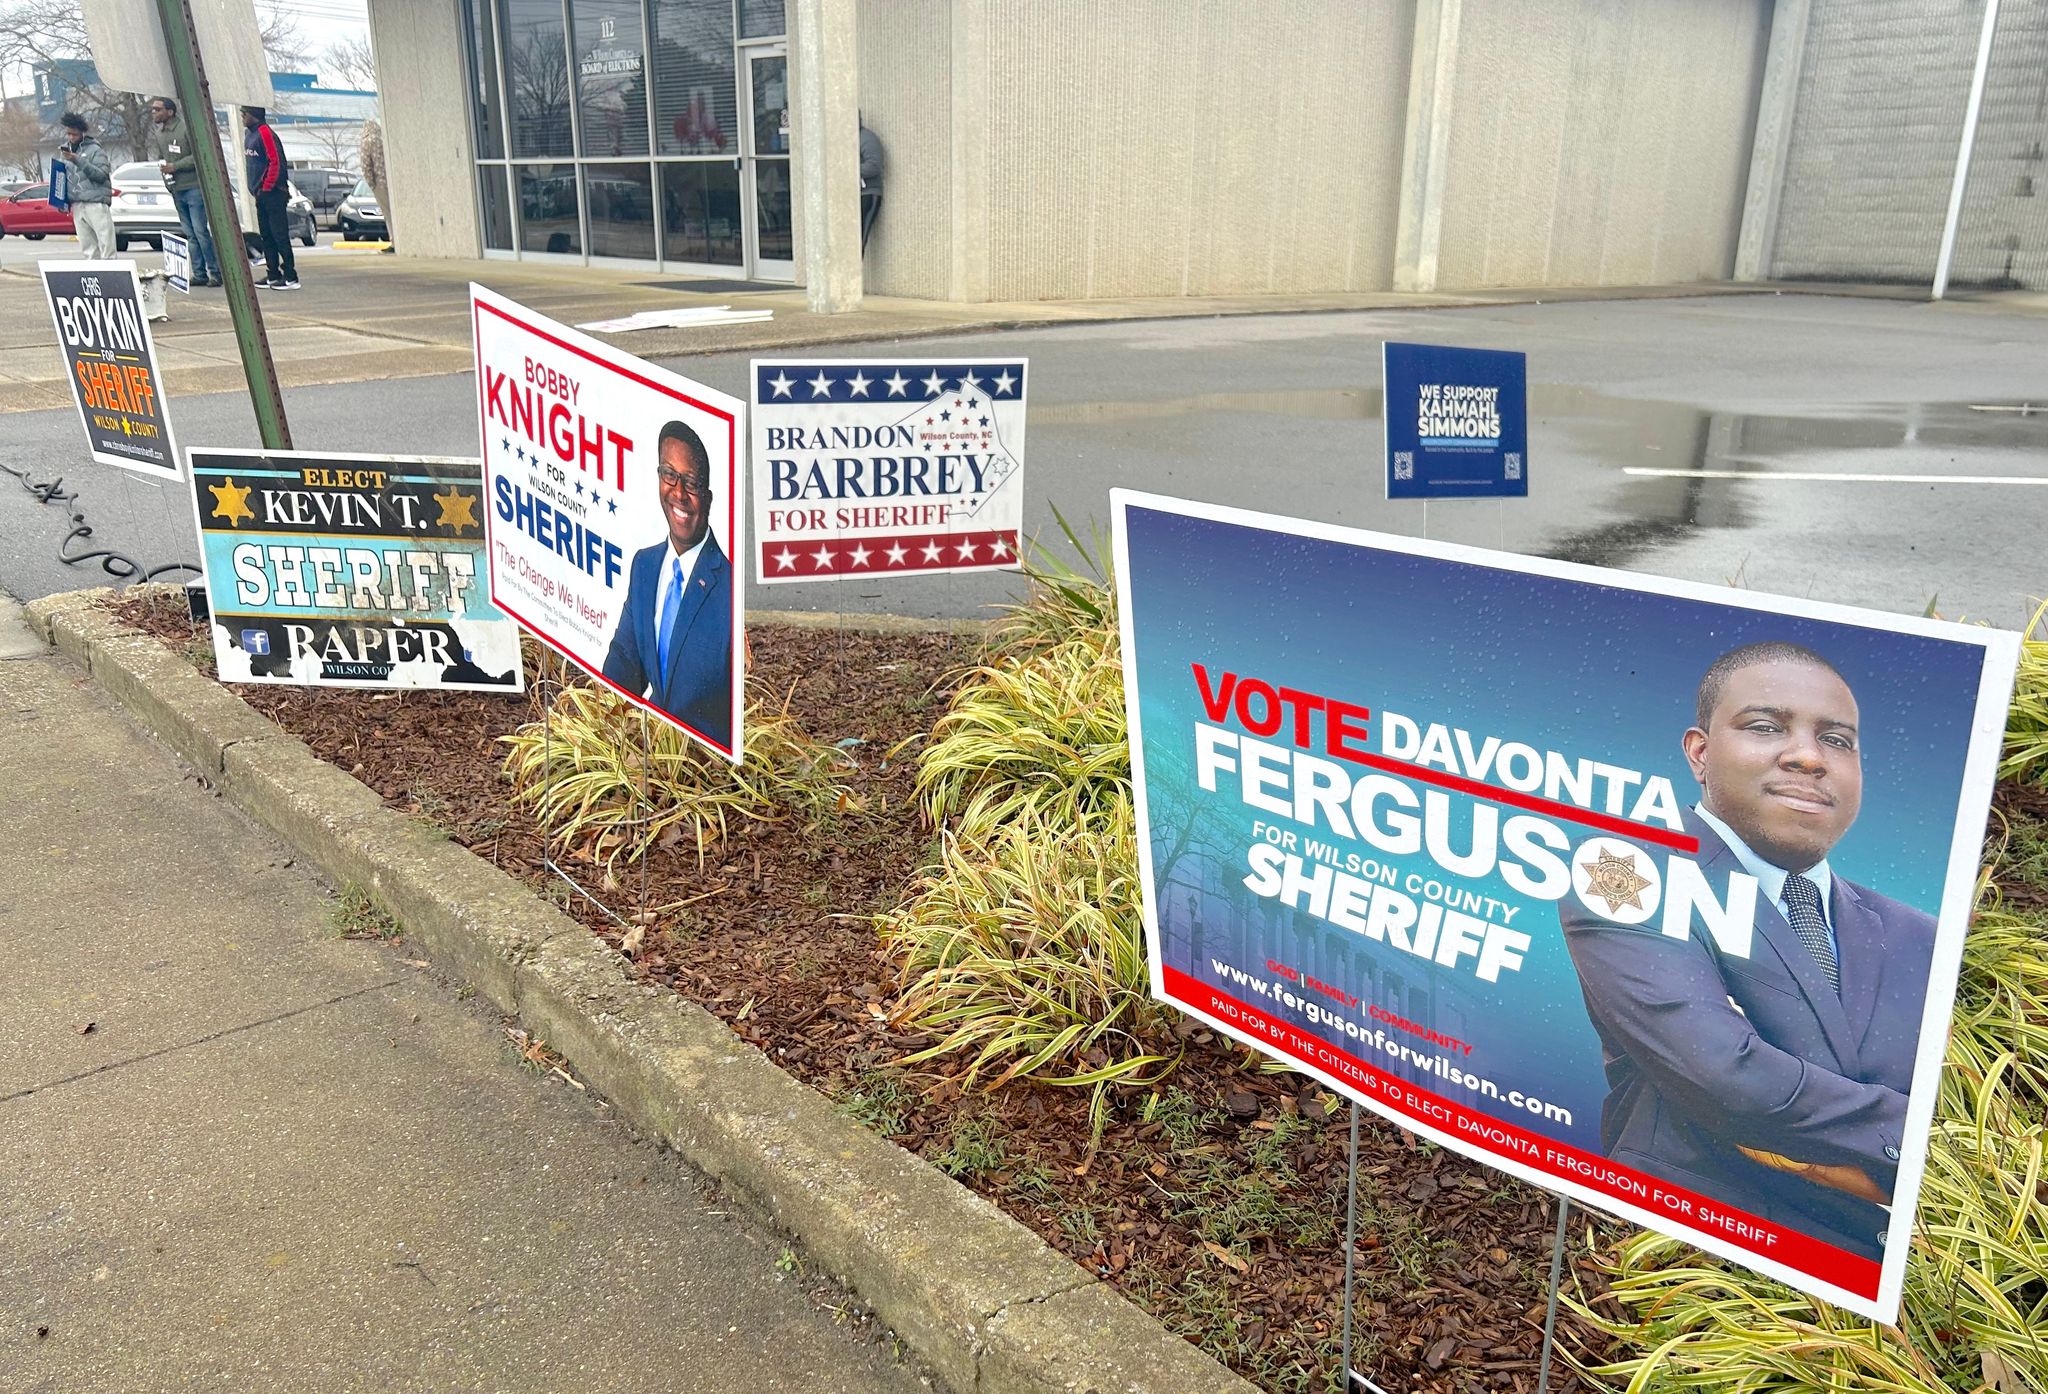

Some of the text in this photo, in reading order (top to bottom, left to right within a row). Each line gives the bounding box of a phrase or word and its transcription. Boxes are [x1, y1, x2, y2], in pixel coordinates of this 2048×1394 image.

[601, 20, 615, 38] 112
[81, 277, 102, 297] CHRIS
[56, 296, 144, 352] BOYKIN
[101, 349, 116, 362] FOR
[77, 360, 155, 417] SHERIFF
[525, 356, 580, 406] BOBBY
[1419, 384, 1499, 402] WE SUPPORT
[93, 415, 160, 439] WILSON COUNTY
[486, 364, 634, 492] KNIGHT
[1418, 416, 1501, 438] SIMMONS
[1419, 399, 1500, 419] KAHMAHL
[767, 425, 915, 450] BRANDON
[920, 431, 993, 442] Wilson County, NC
[302, 467, 387, 489] ELECT
[528, 473, 588, 518] WILSON COUNTY
[547, 463, 565, 486] FOR
[767, 454, 996, 501] BARBREY
[261, 489, 428, 530] KEVIN T.
[495, 474, 623, 589] SHERIFF
[768, 503, 953, 532] FOR SHERIFF
[233, 543, 476, 612] SHERIFF
[518, 556, 555, 597] Change
[558, 580, 573, 609] We
[282, 623, 457, 667] RAPER
[326, 664, 369, 675] WILSON
[1190, 662, 1685, 832] VOTE DAVONTA
[1193, 720, 1759, 961] FERGUSON
[1252, 820, 1520, 925] FOR WILSON COUNTY
[1242, 842, 1532, 984] SHERIFF
[1266, 959, 1473, 1057] GOD FAMILY COMMUNITY
[1210, 958, 1573, 1127] www.fergusonforwilson.com
[1211, 996, 1778, 1248] PAID FOR BY THE CITIZENS TO ELECT DAVONTA FERGUSON FOR SHERIFF
